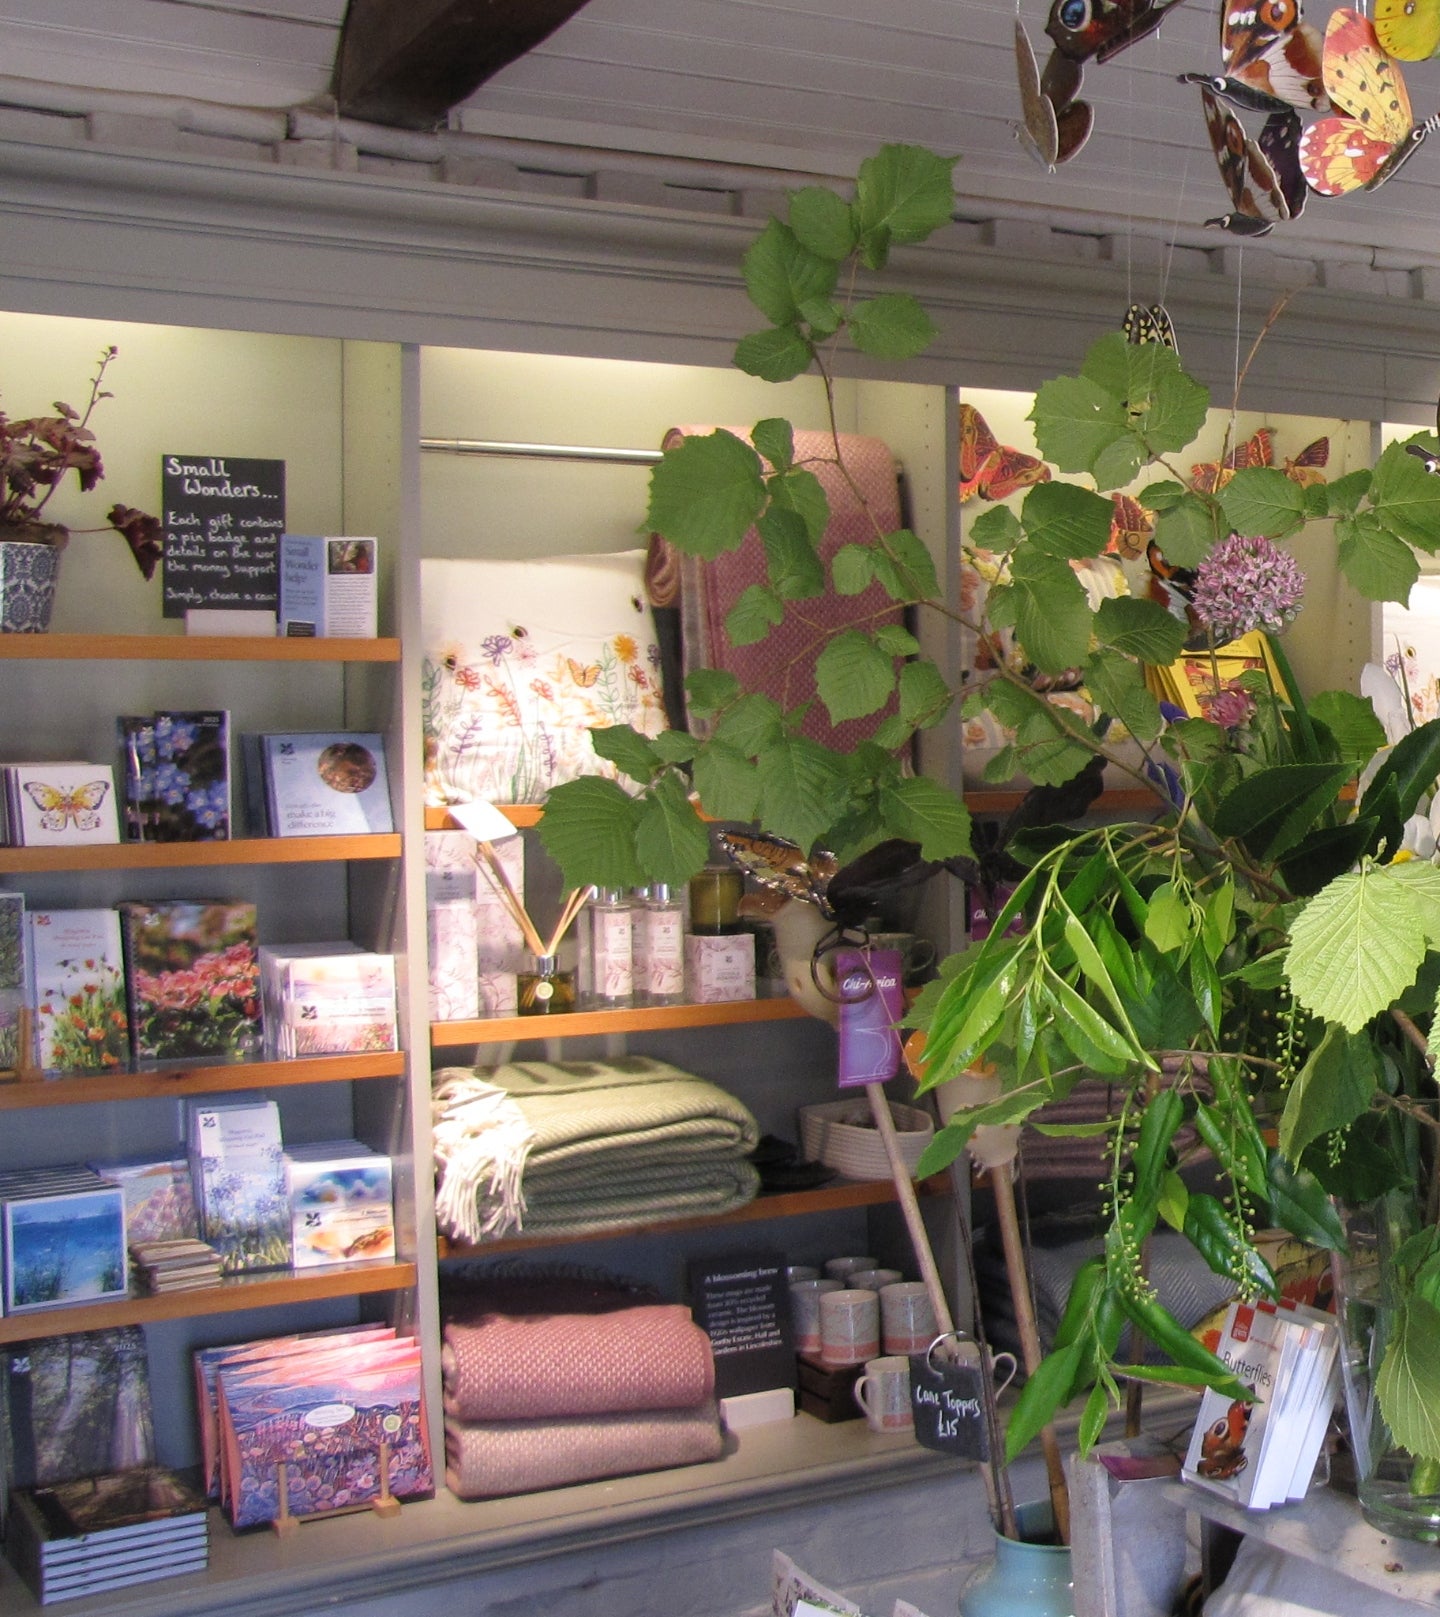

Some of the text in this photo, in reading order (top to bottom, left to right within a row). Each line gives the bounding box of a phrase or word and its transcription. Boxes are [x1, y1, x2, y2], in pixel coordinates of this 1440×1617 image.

[167, 457, 231, 477] Small
[168, 511, 284, 533] Each gift contains
[181, 532, 204, 546] pin
[208, 532, 249, 548] badge
[254, 533, 277, 543] and
[166, 545, 206, 557] details
[213, 550, 228, 558] on
[232, 546, 251, 558] the
[167, 560, 189, 571] the
[192, 564, 231, 578] money
[705, 1267, 778, 1283] A blossoming brew
[1222, 1350, 1272, 1387] Butterflies
[916, 1384, 980, 1418] Cane Toppers
